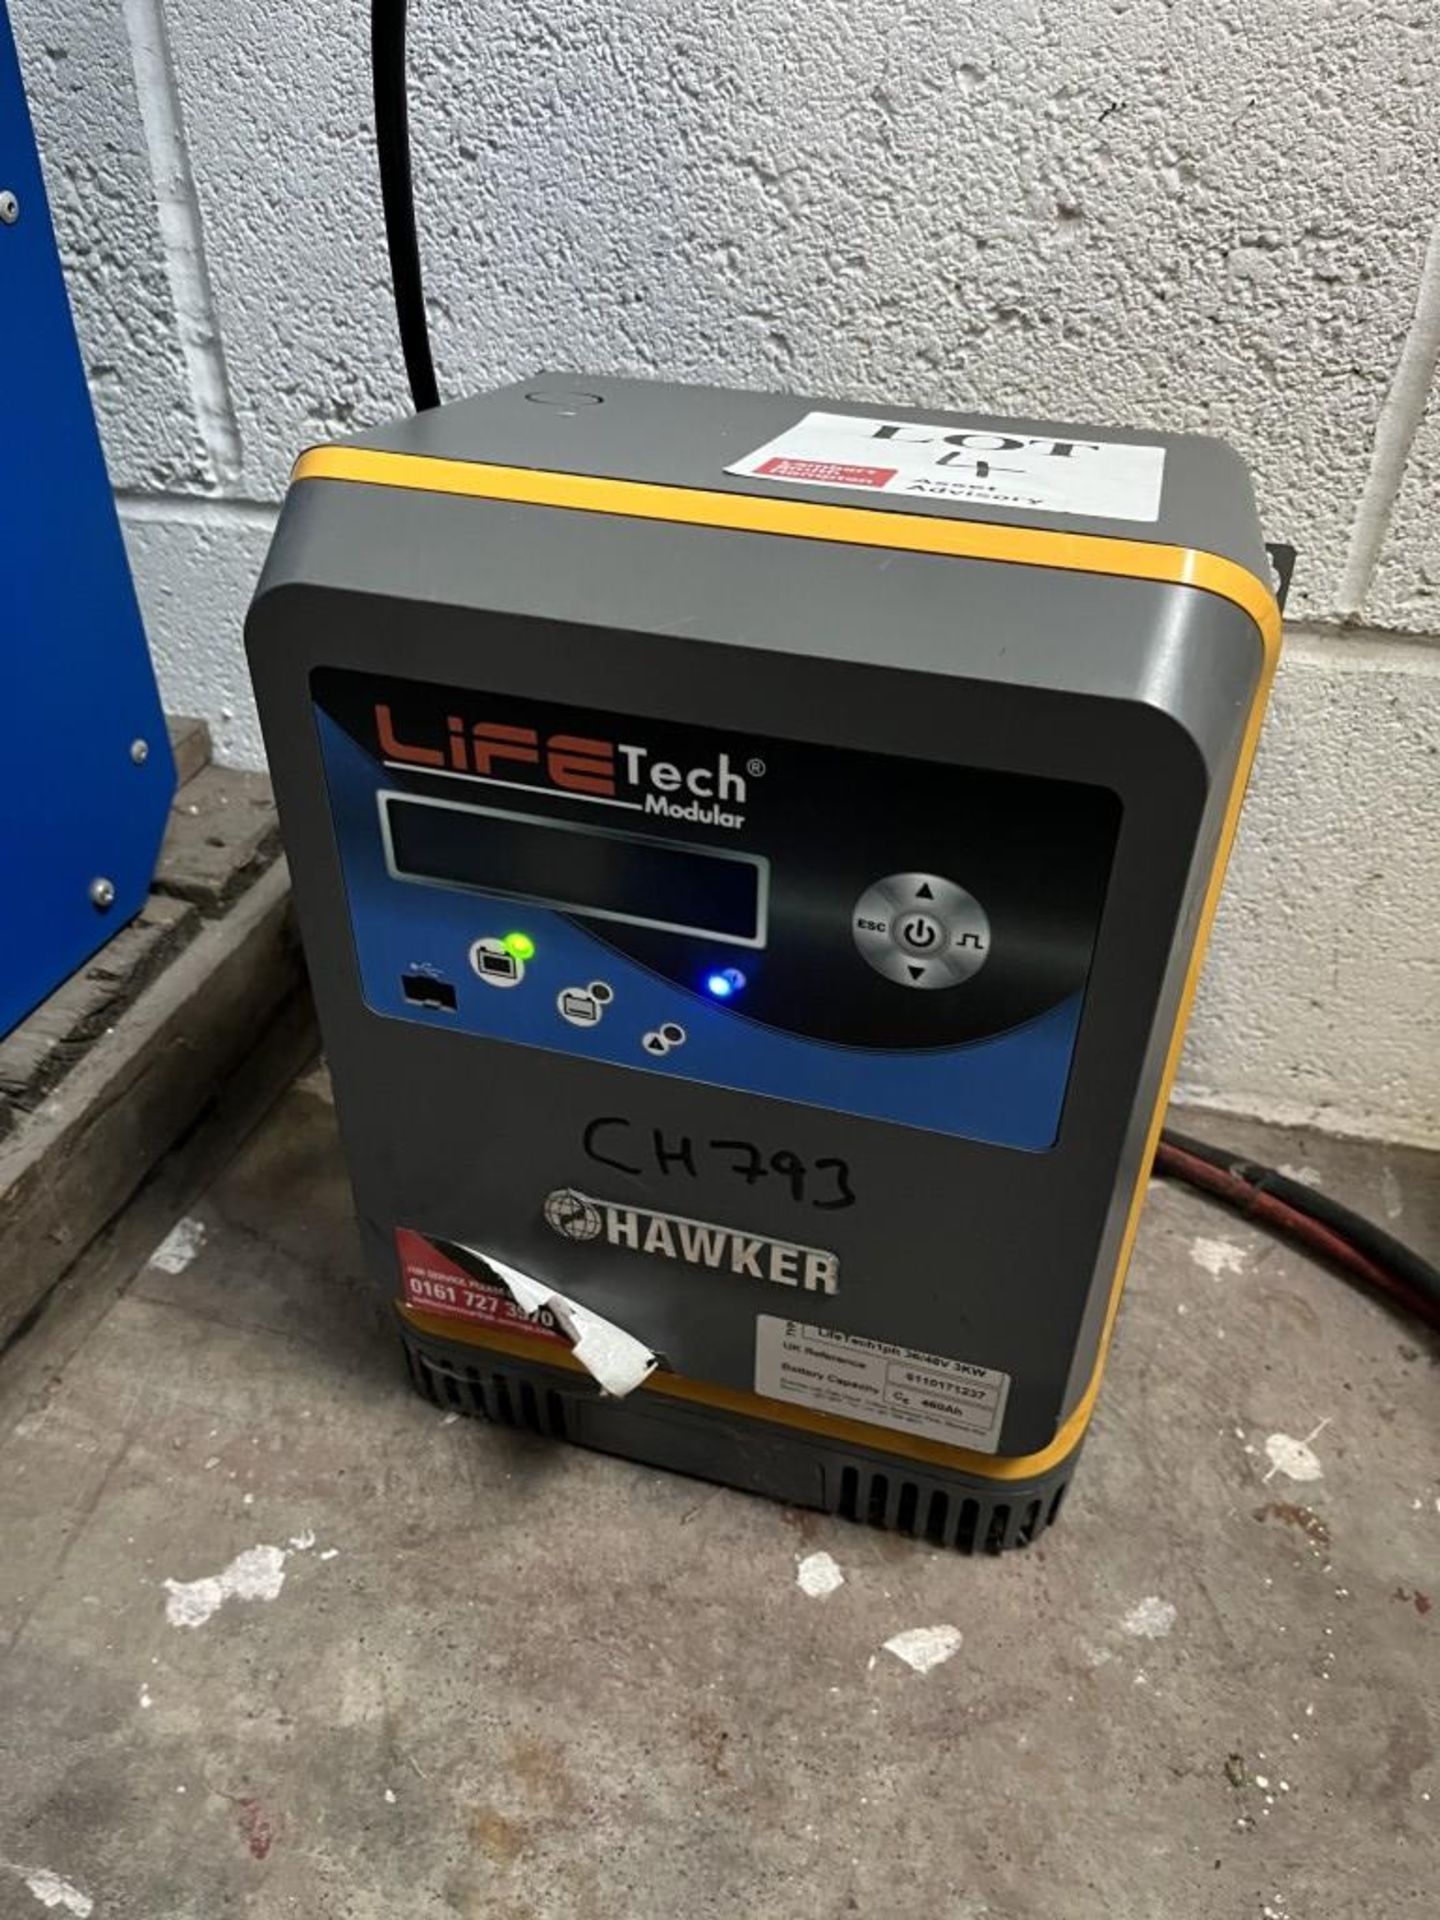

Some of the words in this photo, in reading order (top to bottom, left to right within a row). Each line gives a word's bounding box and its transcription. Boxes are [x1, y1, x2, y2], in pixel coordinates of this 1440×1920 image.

[869, 424, 1100, 459] LOT
[935, 450, 1026, 478] 4
[904, 484, 1045, 505] Advisory
[914, 478, 998, 493] Asset
[644, 793, 746, 830] Modular
[857, 918, 887, 933] ESC
[605, 1207, 840, 1295] HAWKER
[410, 1277, 456, 1303] 0161
[463, 1290, 499, 1313] 727
[826, 1373, 880, 1396] Capacity
